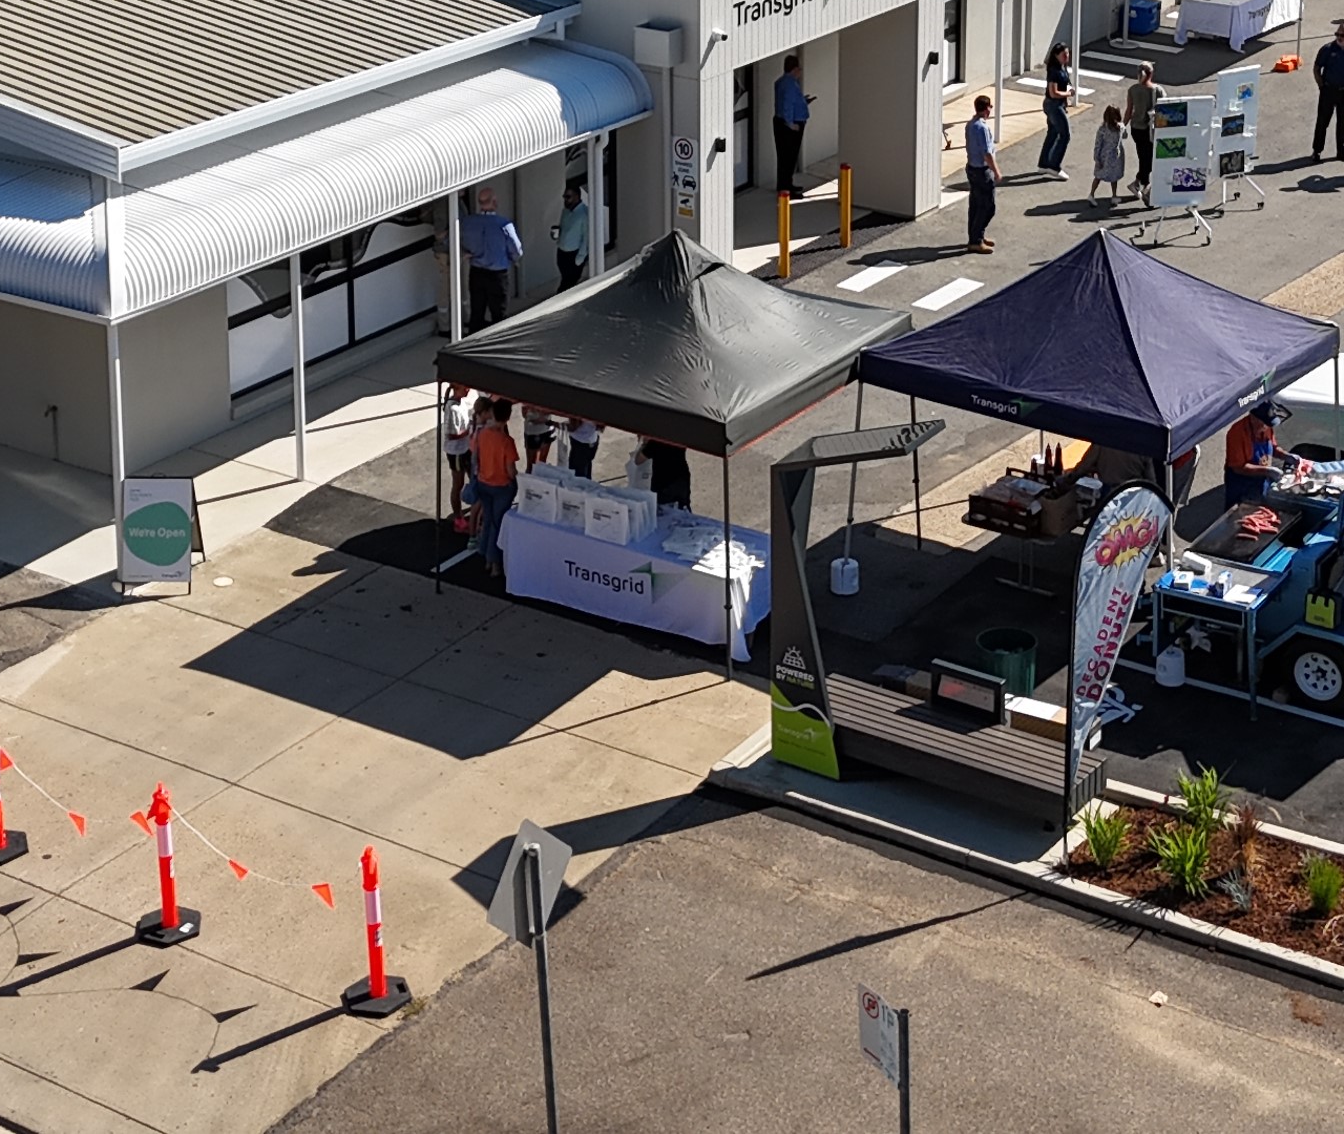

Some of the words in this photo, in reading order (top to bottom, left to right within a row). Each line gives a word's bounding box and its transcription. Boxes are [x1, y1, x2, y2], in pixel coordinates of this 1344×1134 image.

[678, 142, 690, 156] 10
[971, 394, 1018, 415] Transgrid
[129, 527, 155, 538] We're
[157, 527, 186, 539] Open
[1095, 515, 1159, 566] OMG!
[564, 560, 644, 595] Transgrid
[1076, 586, 1122, 696] DECADENT
[1086, 591, 1133, 702] DONUTS
[776, 665, 815, 682] POWERED
[776, 673, 786, 681] BY
